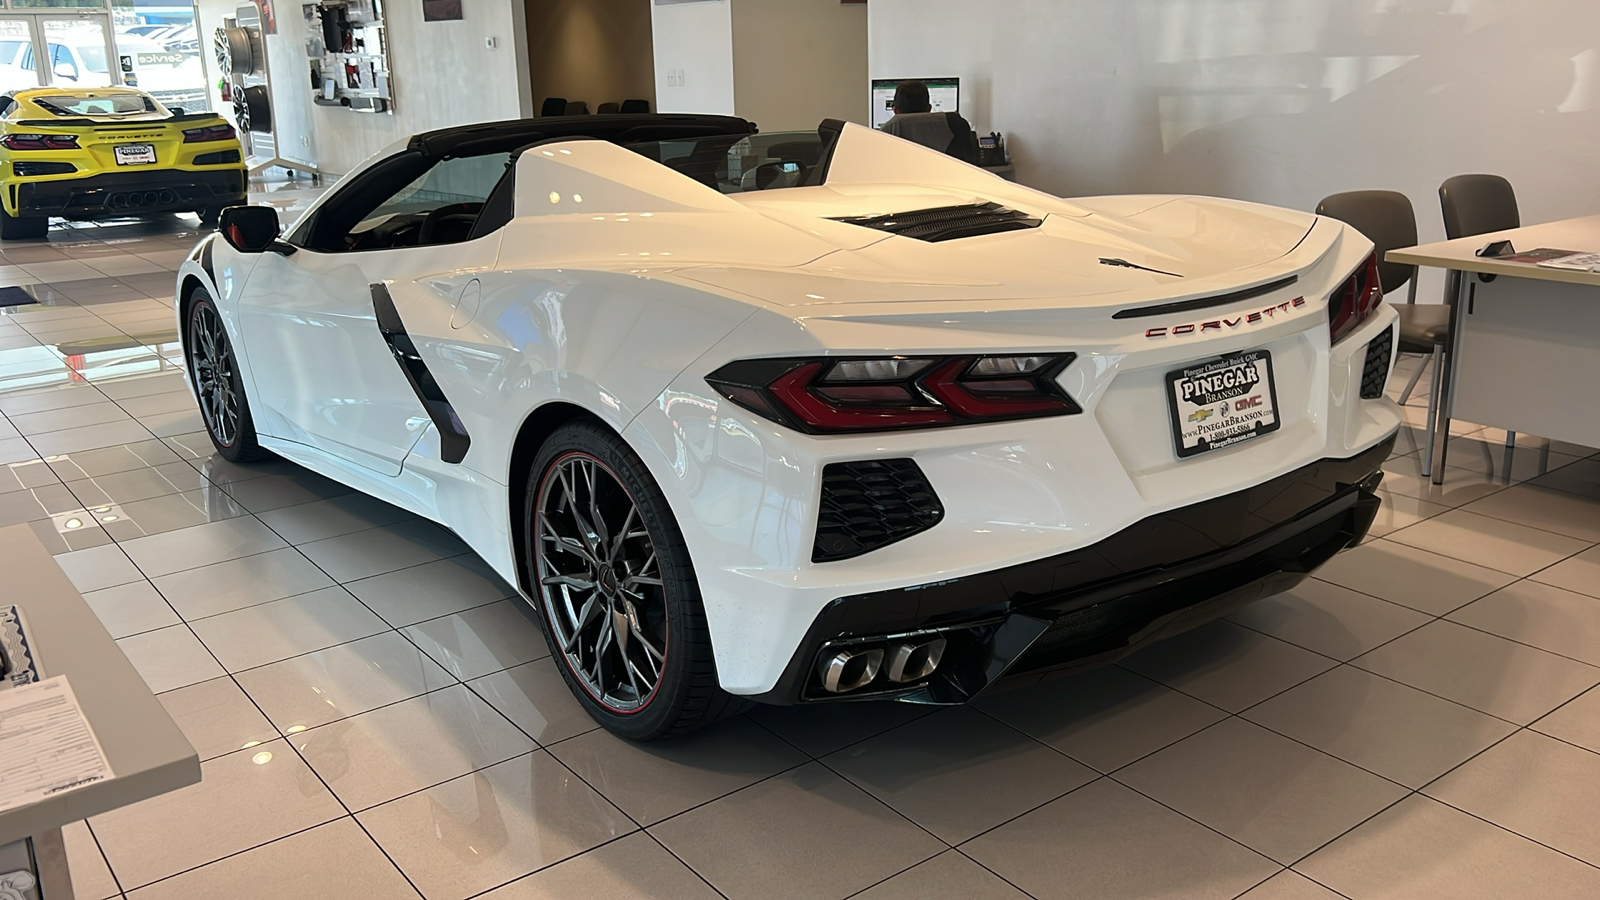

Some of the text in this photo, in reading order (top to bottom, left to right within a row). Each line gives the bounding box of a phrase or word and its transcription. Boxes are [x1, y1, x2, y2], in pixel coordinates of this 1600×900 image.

[1145, 295, 1306, 338] CORVETTE
[1183, 352, 1259, 377] Pinegar Chevrolet Buick GMC
[1182, 366, 1258, 399] PINEGAR
[1234, 394, 1263, 412] GMC
